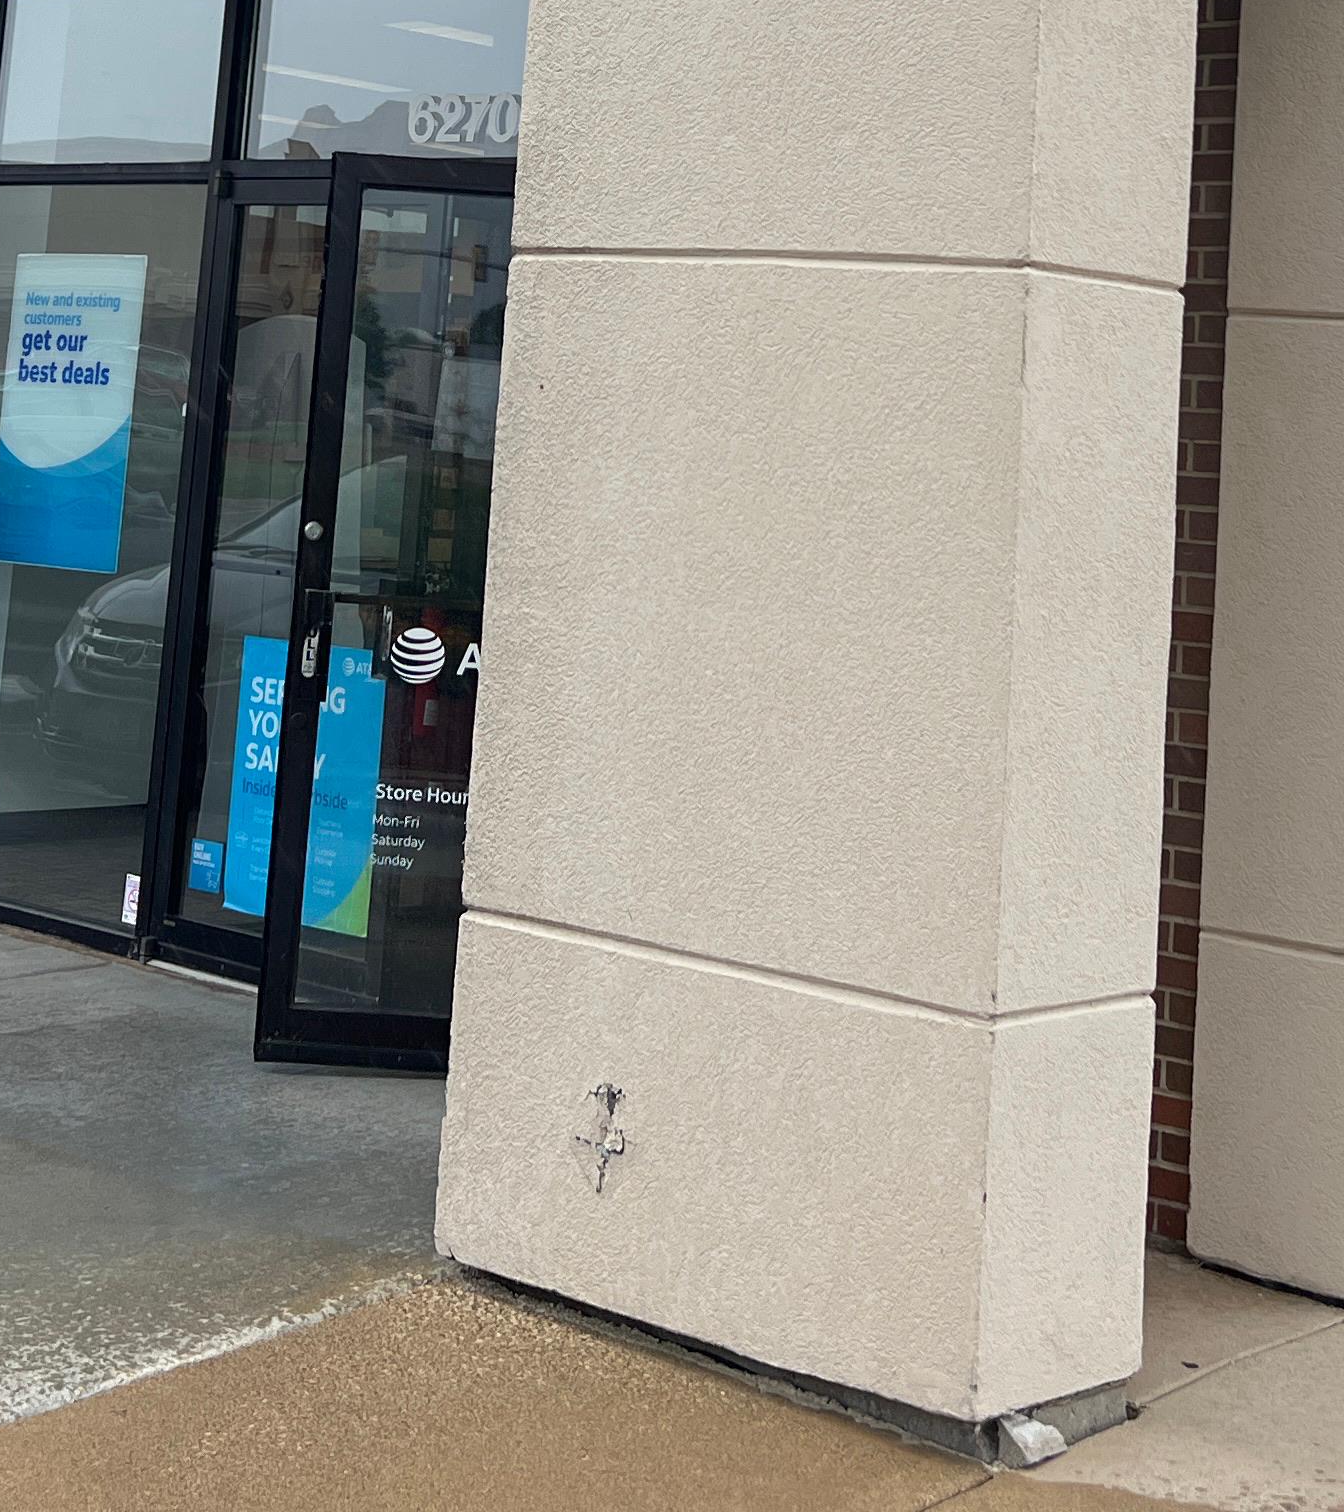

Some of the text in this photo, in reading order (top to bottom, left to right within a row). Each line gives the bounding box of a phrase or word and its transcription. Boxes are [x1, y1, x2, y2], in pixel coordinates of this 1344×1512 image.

[408, 94, 520, 143] 6270
[25, 292, 121, 312] New and existing
[24, 312, 82, 326] customers
[21, 330, 88, 356] get our
[18, 358, 110, 386] best deals
[249, 709, 281, 739] YO
[376, 784, 469, 805] Store Hour
[373, 814, 420, 829] Mon-Fri
[372, 834, 425, 851] Saturday
[370, 853, 414, 870] Sunday
